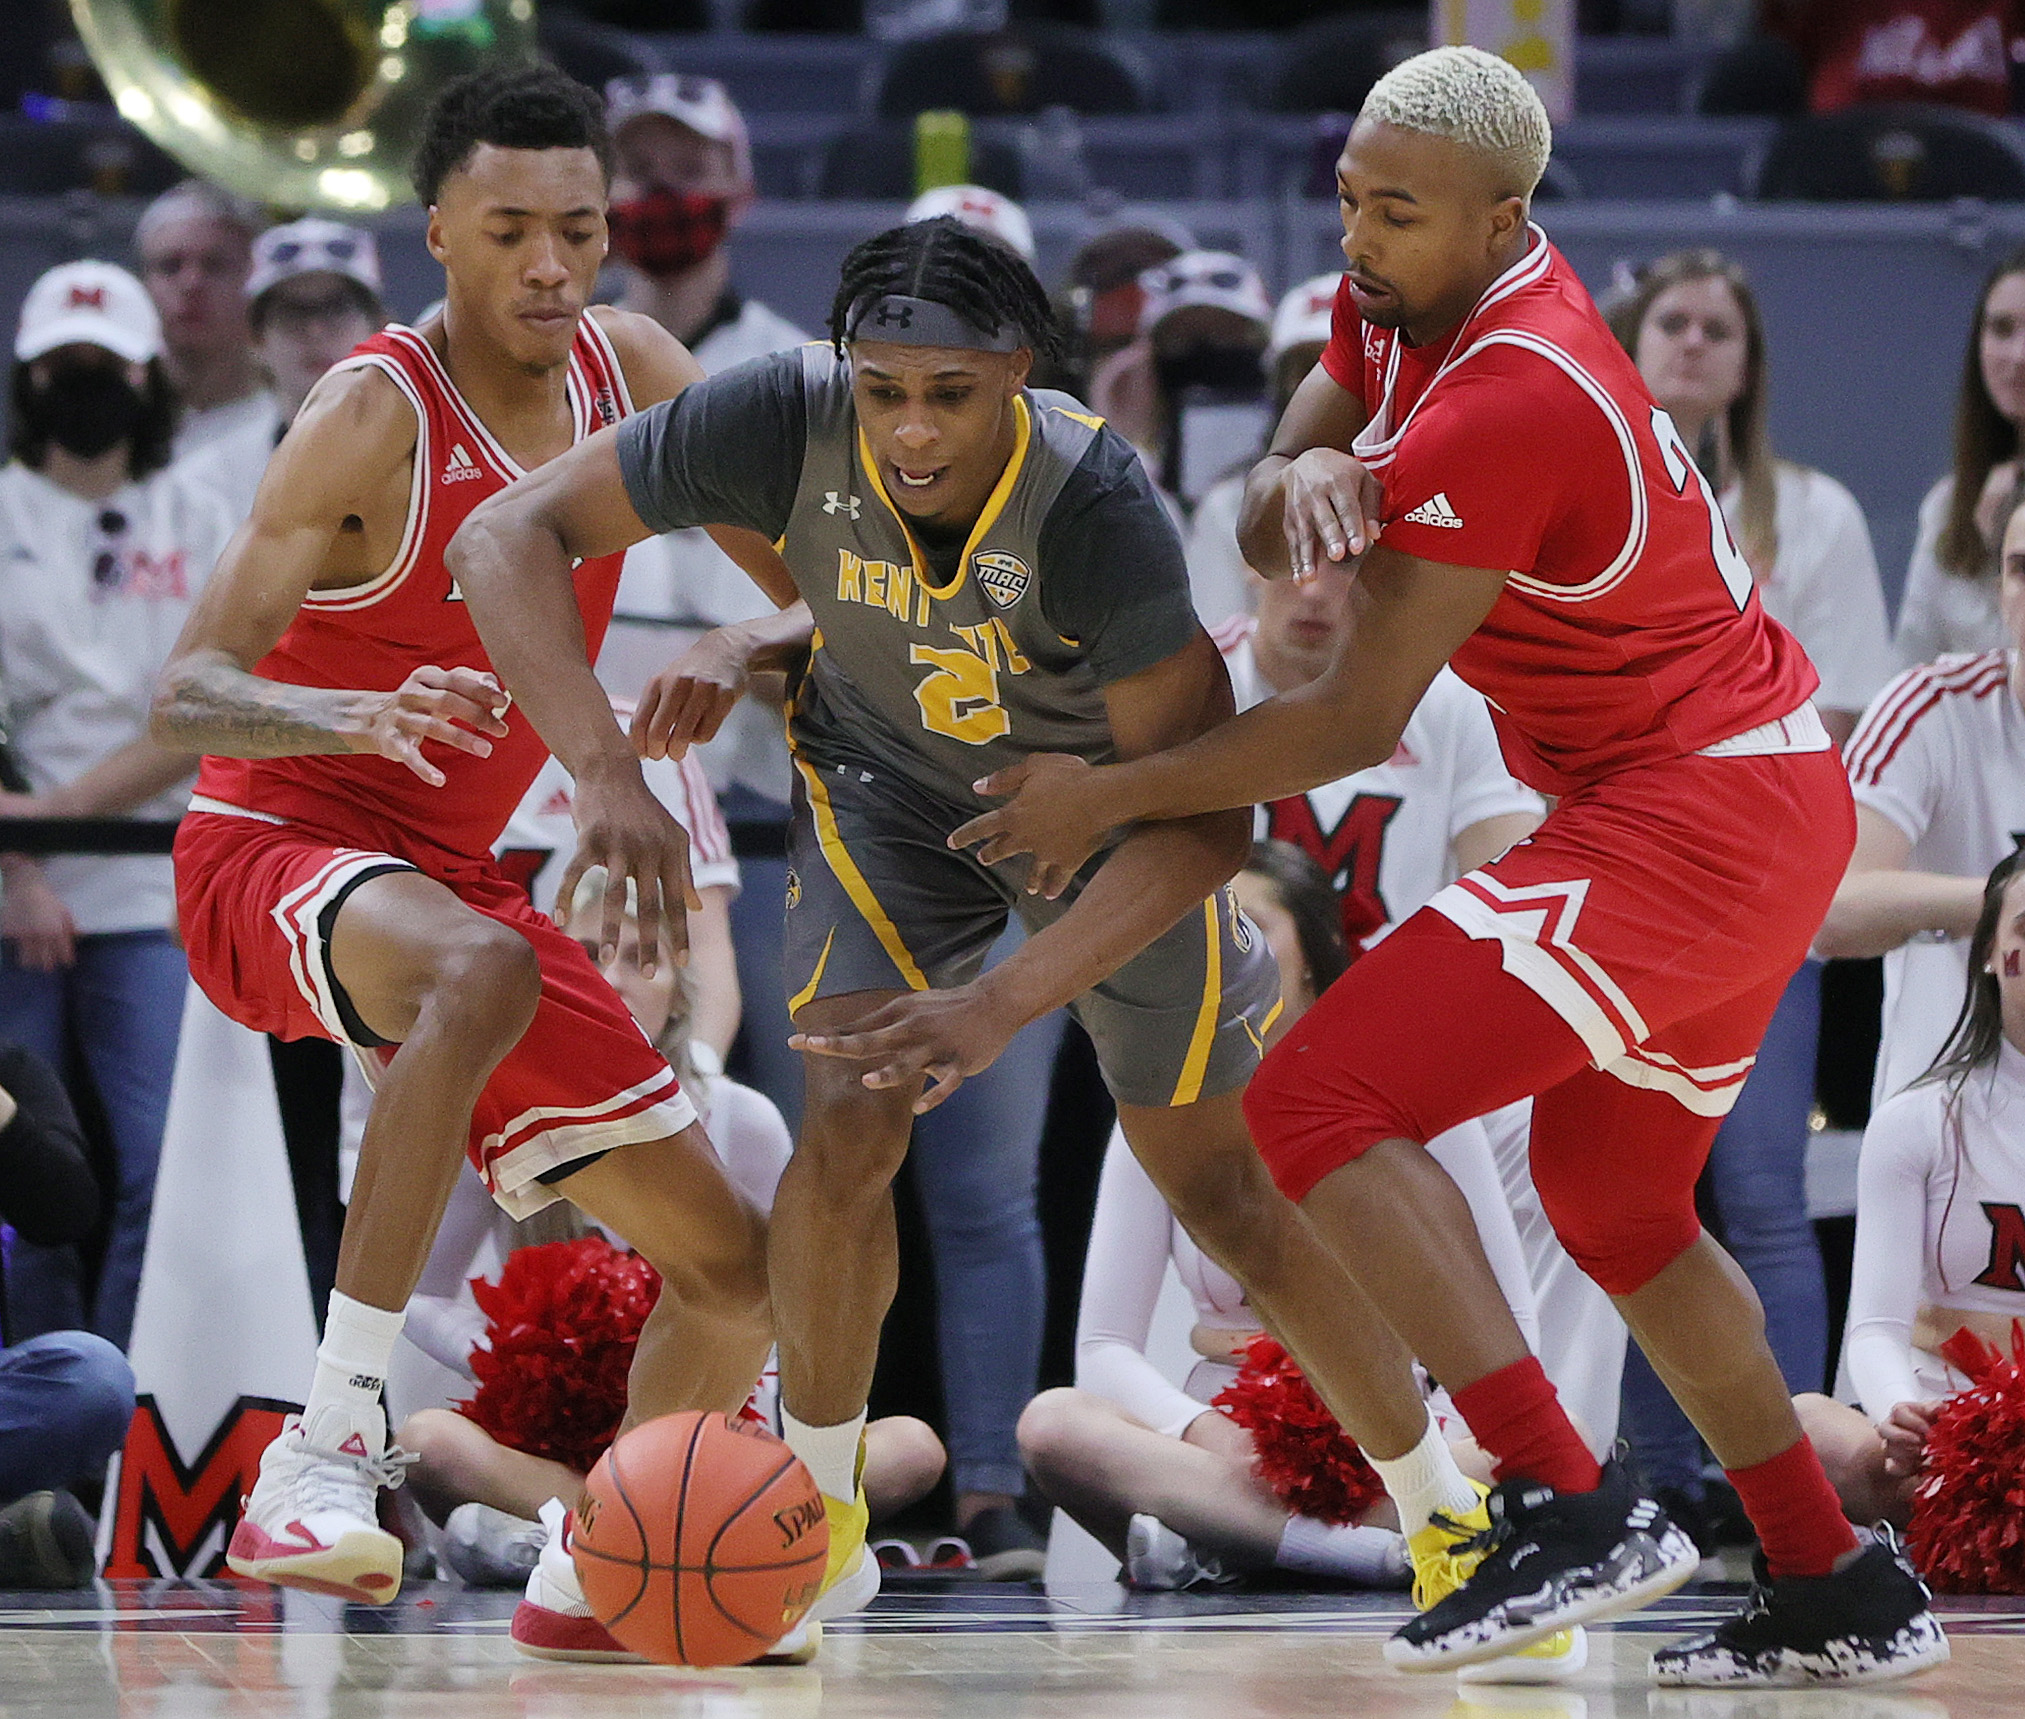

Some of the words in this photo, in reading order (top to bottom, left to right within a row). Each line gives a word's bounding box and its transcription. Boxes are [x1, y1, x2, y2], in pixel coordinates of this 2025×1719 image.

[441, 467, 483, 485] adidas
[1404, 511, 1463, 529] adidas
[978, 566, 1026, 591] MAC
[909, 642, 1011, 745] 2
[1263, 790, 1404, 945] M
[102, 1393, 306, 1578] M
